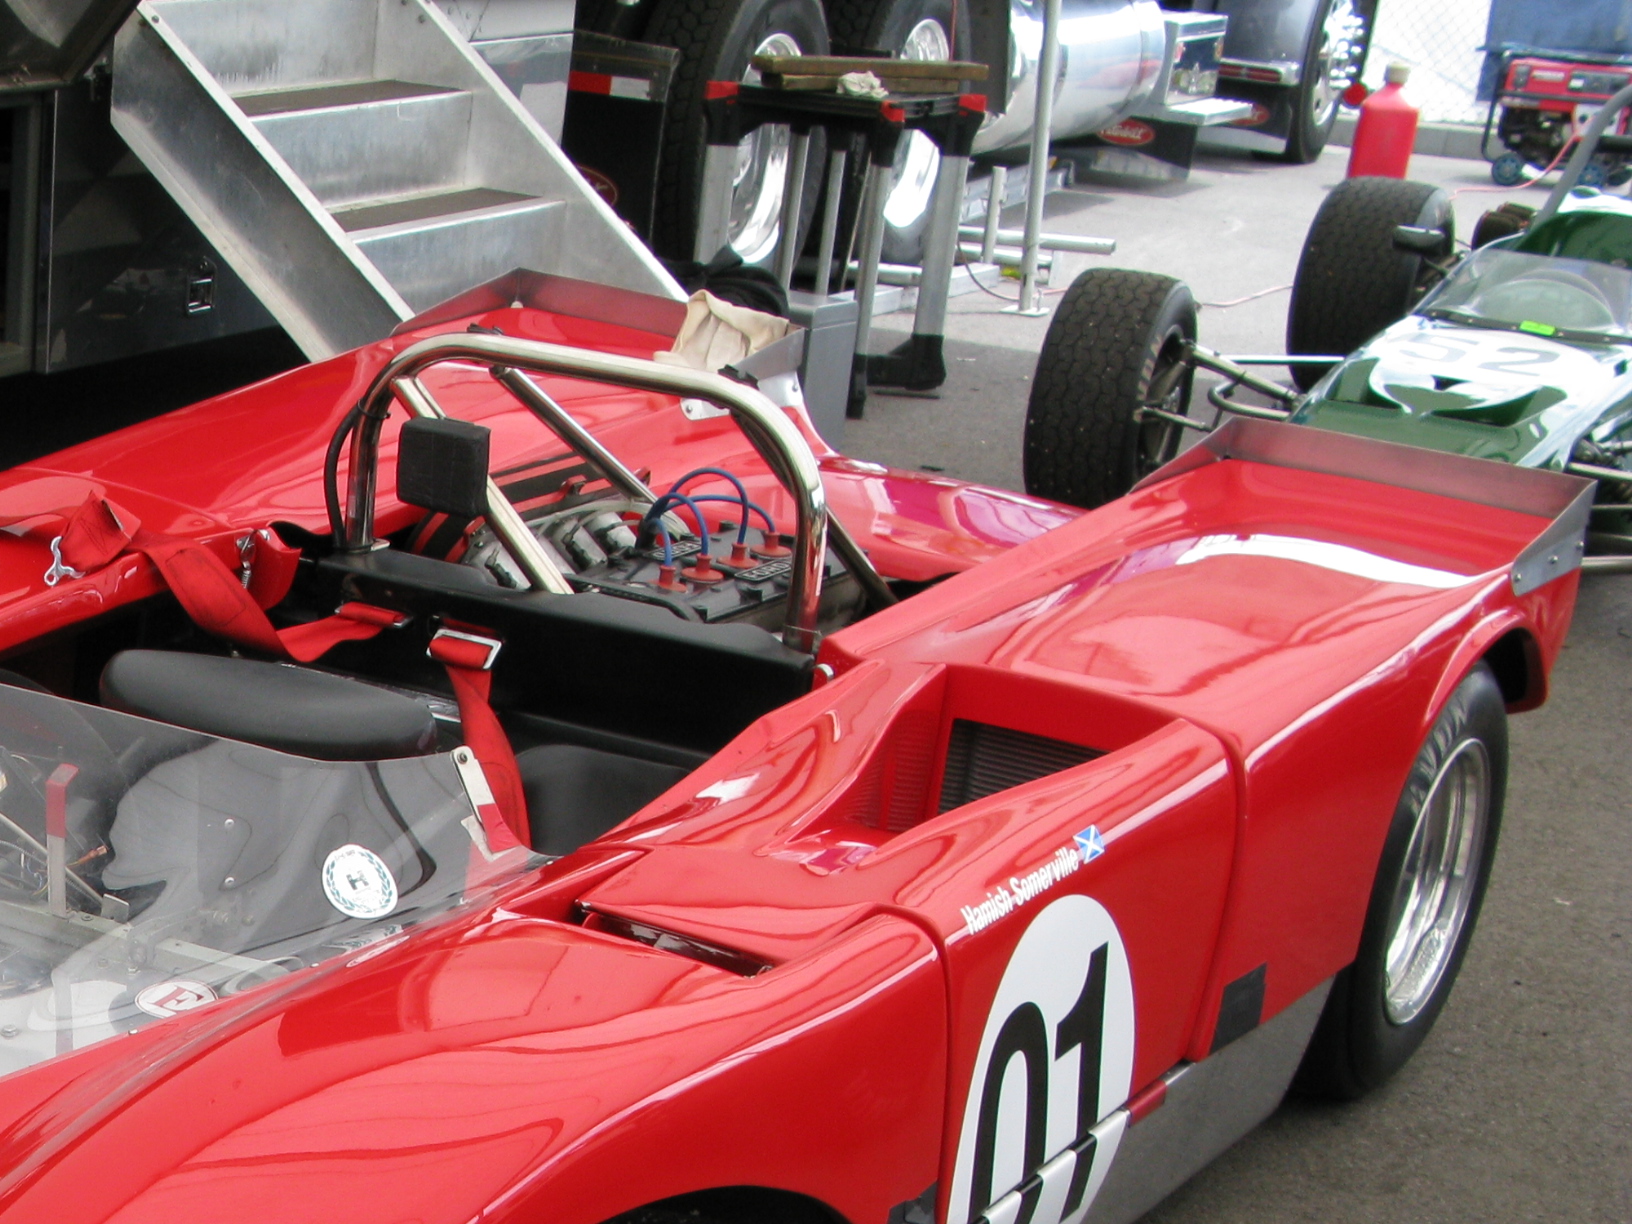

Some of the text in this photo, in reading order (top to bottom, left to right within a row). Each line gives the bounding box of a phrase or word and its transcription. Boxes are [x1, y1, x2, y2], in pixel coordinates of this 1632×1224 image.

[1399, 332, 1560, 377] 52
[960, 846, 1079, 935] Hamish Somerville
